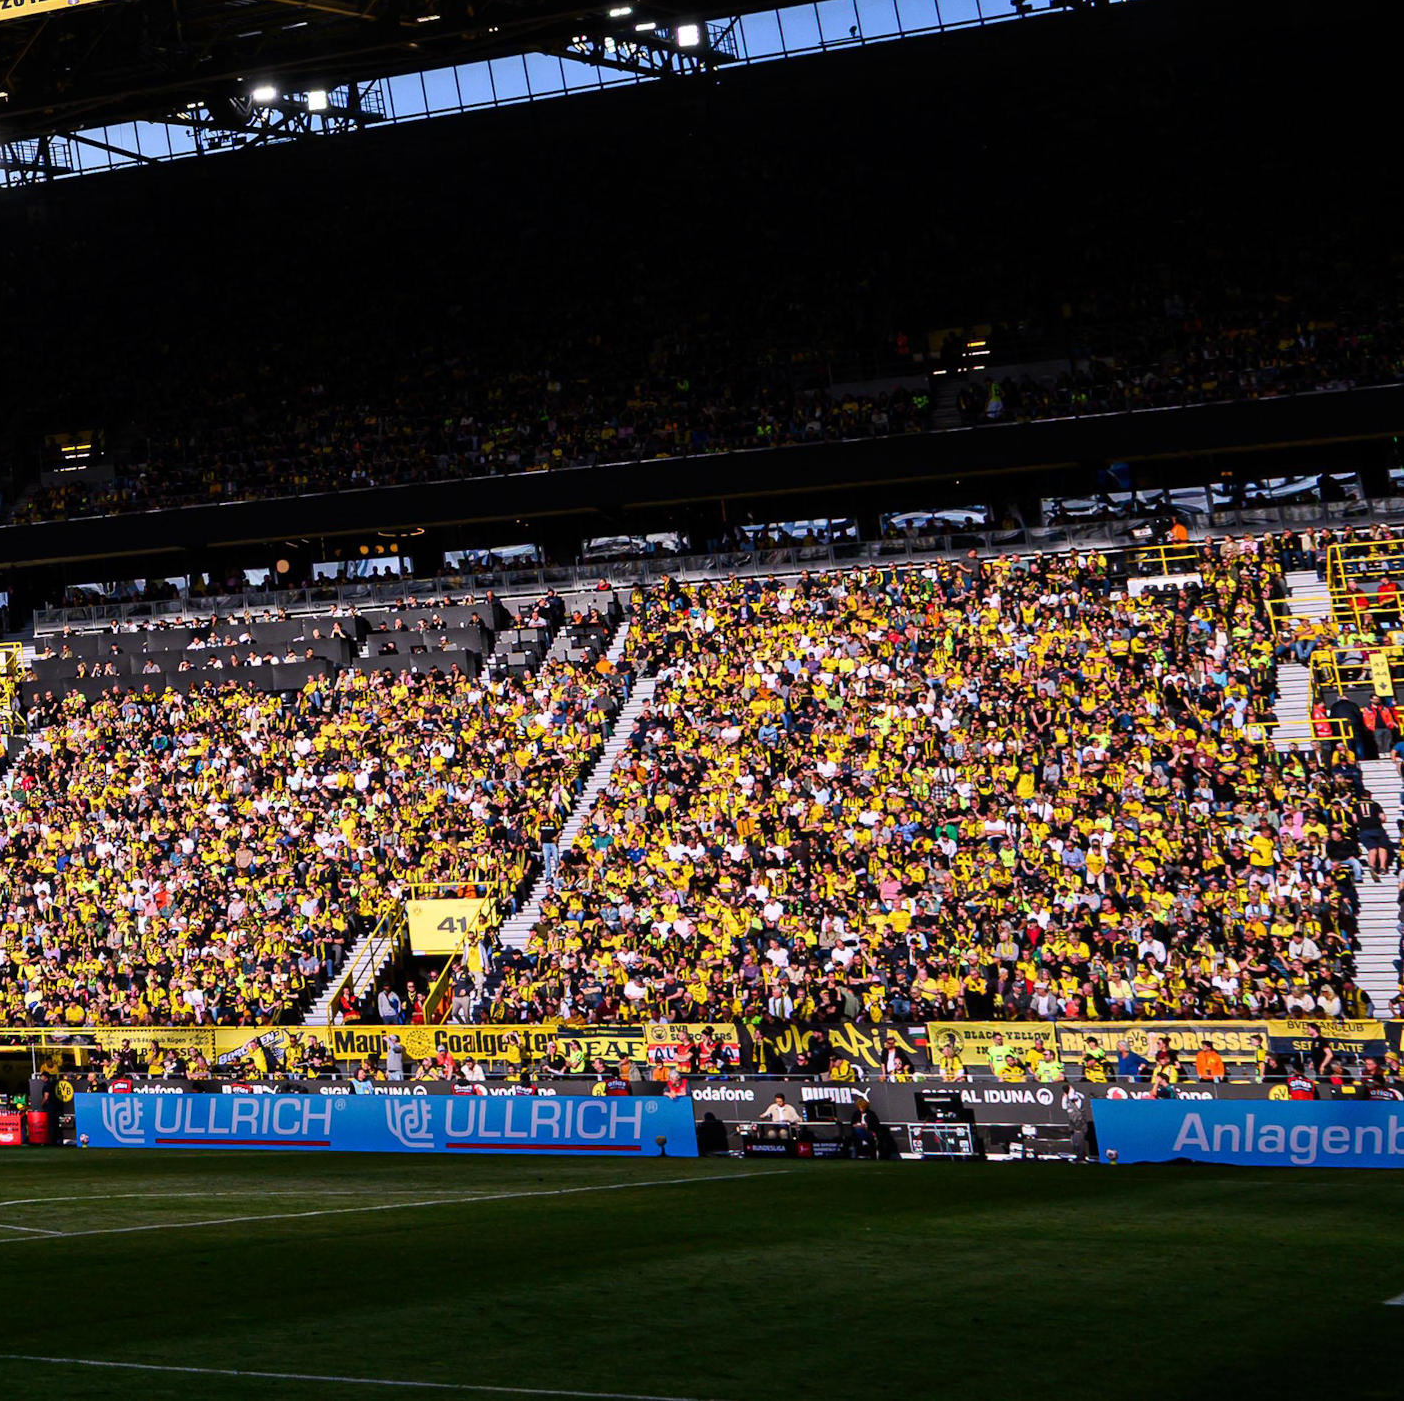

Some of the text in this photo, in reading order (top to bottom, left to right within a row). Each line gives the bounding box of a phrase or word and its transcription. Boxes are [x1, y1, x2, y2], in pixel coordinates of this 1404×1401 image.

[437, 917, 467, 934] 41
[334, 1031, 399, 1055] Magi
[320, 1086, 351, 1095] SIGN
[801, 1087, 852, 1103] PUMA
[984, 1090, 1035, 1103] IDUNA
[155, 1097, 331, 1135] ULLRICH
[445, 1099, 641, 1139] ULLRICH
